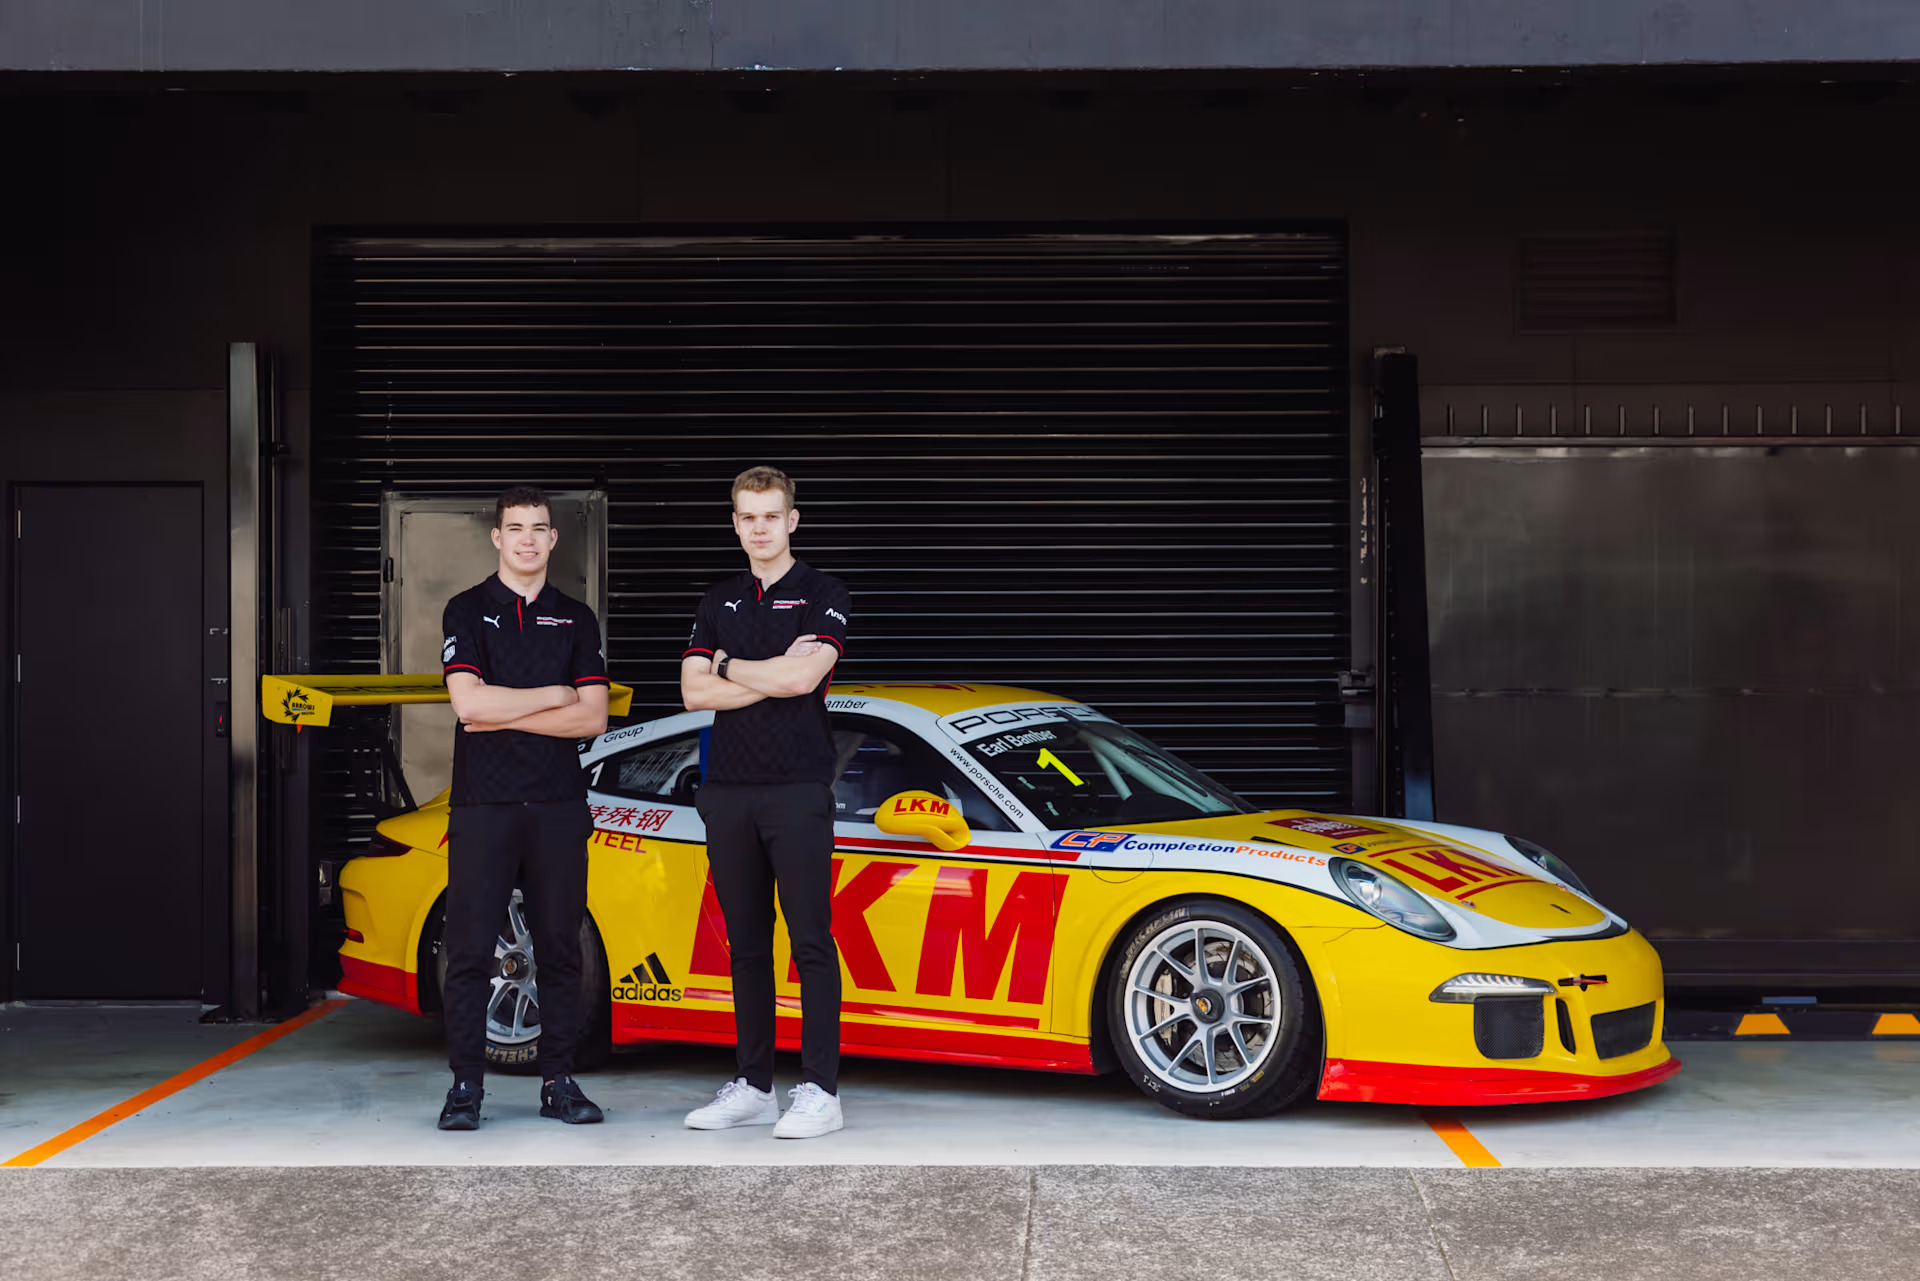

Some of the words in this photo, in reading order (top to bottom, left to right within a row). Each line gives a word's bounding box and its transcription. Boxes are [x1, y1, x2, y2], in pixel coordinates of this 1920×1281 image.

[826, 699, 869, 709] amber
[949, 706, 1100, 734] PORSC
[604, 727, 643, 743] Group
[976, 738, 1013, 757] Earl
[1003, 729, 1058, 748] Bamber
[1036, 747, 1084, 786] 1
[950, 748, 1024, 819] www.porsche.com
[894, 799, 950, 816] LKM
[593, 827, 647, 854] TEEL
[612, 983, 682, 1001] adidas
[485, 1045, 537, 1063] CHELIN
